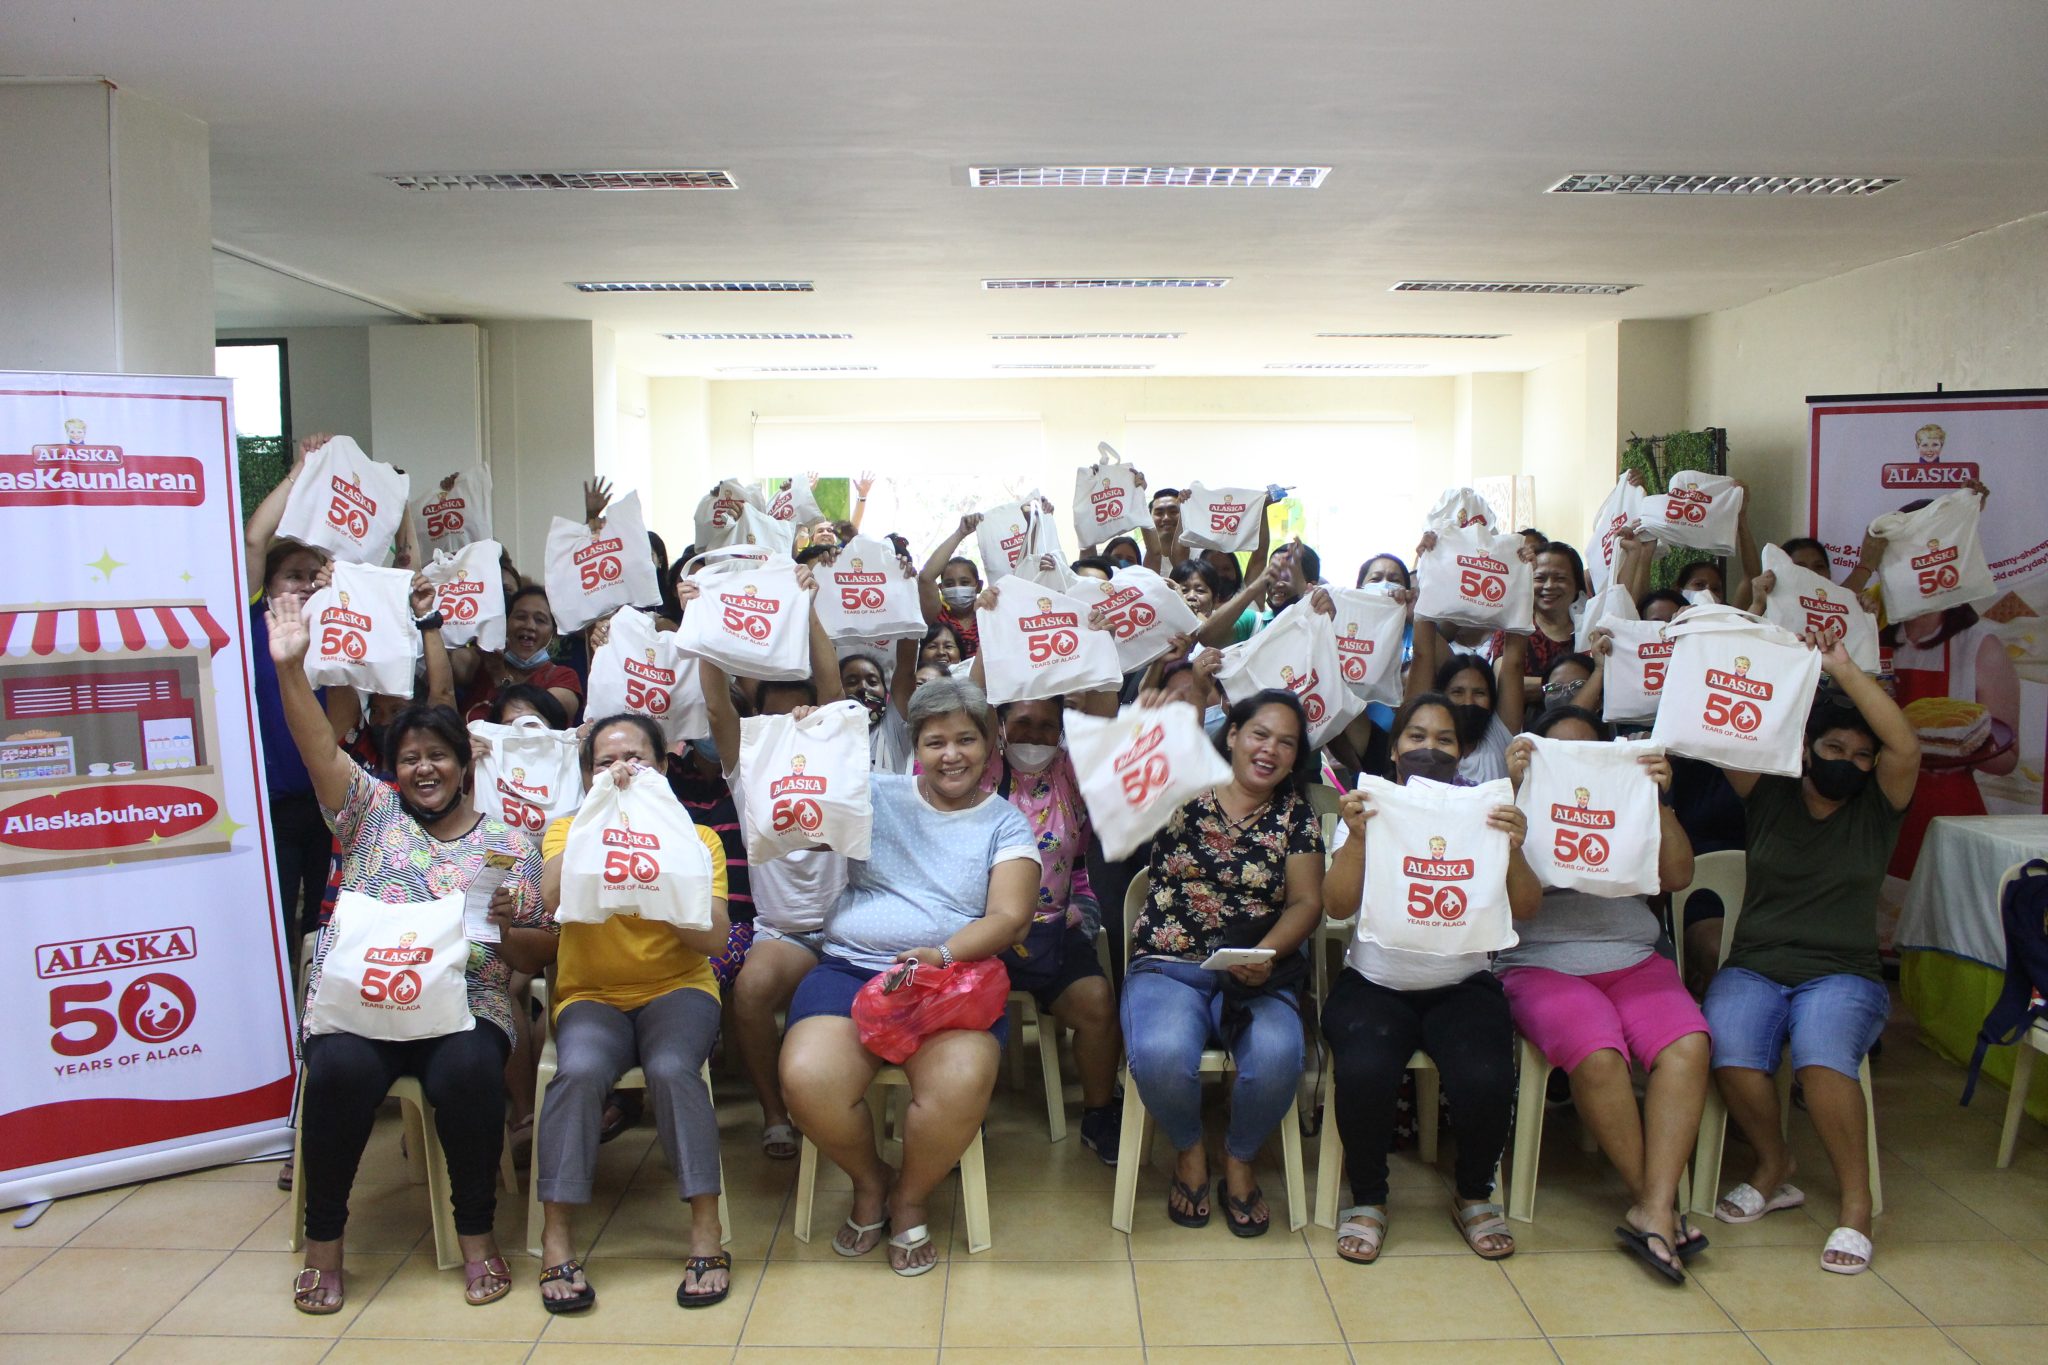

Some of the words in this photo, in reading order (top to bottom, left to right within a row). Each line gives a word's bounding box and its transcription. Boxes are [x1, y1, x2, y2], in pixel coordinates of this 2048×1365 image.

[37, 448, 119, 461] ALASKA
[0, 467, 196, 491] asKaunlaran
[1887, 468, 1974, 483] ALASKA
[333, 480, 373, 512] ALASKA
[1092, 490, 1123, 501] ALASKA
[328, 496, 368, 538] 50
[424, 500, 462, 514] ALASKA
[1095, 500, 1123, 522] 50
[1666, 499, 1706, 522] 50
[427, 511, 464, 537] 50
[1211, 515, 1240, 532] 50
[576, 541, 619, 563] ALASKA
[1004, 534, 1025, 548] ALAS
[1824, 543, 1841, 552] Add
[1843, 545, 1860, 557] 2-i
[1460, 556, 1506, 573] ALASKA
[1914, 549, 1956, 568] ALASKA
[1988, 540, 2048, 570] reamy-shere
[580, 556, 622, 590] 50
[1919, 565, 1959, 594] 50
[441, 583, 481, 594] ALASKA
[1460, 570, 1506, 602] 50
[438, 597, 478, 621] 50
[723, 596, 775, 612] ALASKA
[842, 587, 884, 609] 50
[1098, 590, 1139, 613] ALASKA
[1802, 599, 1846, 612] ALASKA
[323, 610, 368, 629] ALASKA
[722, 607, 771, 640] 50
[1023, 616, 1074, 629] ALASKA
[1108, 603, 1155, 638] 50
[320, 627, 367, 659] 50
[1028, 630, 1079, 662] 50
[1337, 639, 1370, 651] LASKA
[1642, 645, 1674, 655] ALAS
[627, 662, 673, 682] ALASKA
[1032, 661, 1050, 669] YEARS
[1644, 662, 1669, 690] 5
[625, 679, 671, 714] 50
[1709, 673, 1769, 698] ALASKA
[1703, 693, 1762, 733] 50
[1701, 724, 1722, 734] YEARS
[773, 779, 822, 796] ALASKA
[4, 802, 202, 835] Alaskabuhayan
[502, 798, 545, 831] 50
[772, 798, 823, 831] 50
[1554, 808, 1611, 826] ALASKA
[606, 832, 656, 847] ALASKA
[1553, 828, 1610, 866] 50
[603, 851, 660, 883] 50
[1407, 861, 1469, 877] ALASKA
[1553, 860, 1575, 871] YEARS
[1407, 882, 1467, 920] 50
[1407, 918, 1430, 927] YEARS
[44, 933, 190, 973] ALASKA
[368, 950, 427, 963] ALASKA
[360, 968, 422, 1005] 50
[49, 973, 196, 1056] 50
[360, 1001, 384, 1009] YEARS
[55, 1058, 112, 1076] YEARS
[118, 1053, 140, 1066] OF
[146, 1044, 202, 1062] ALAGA
